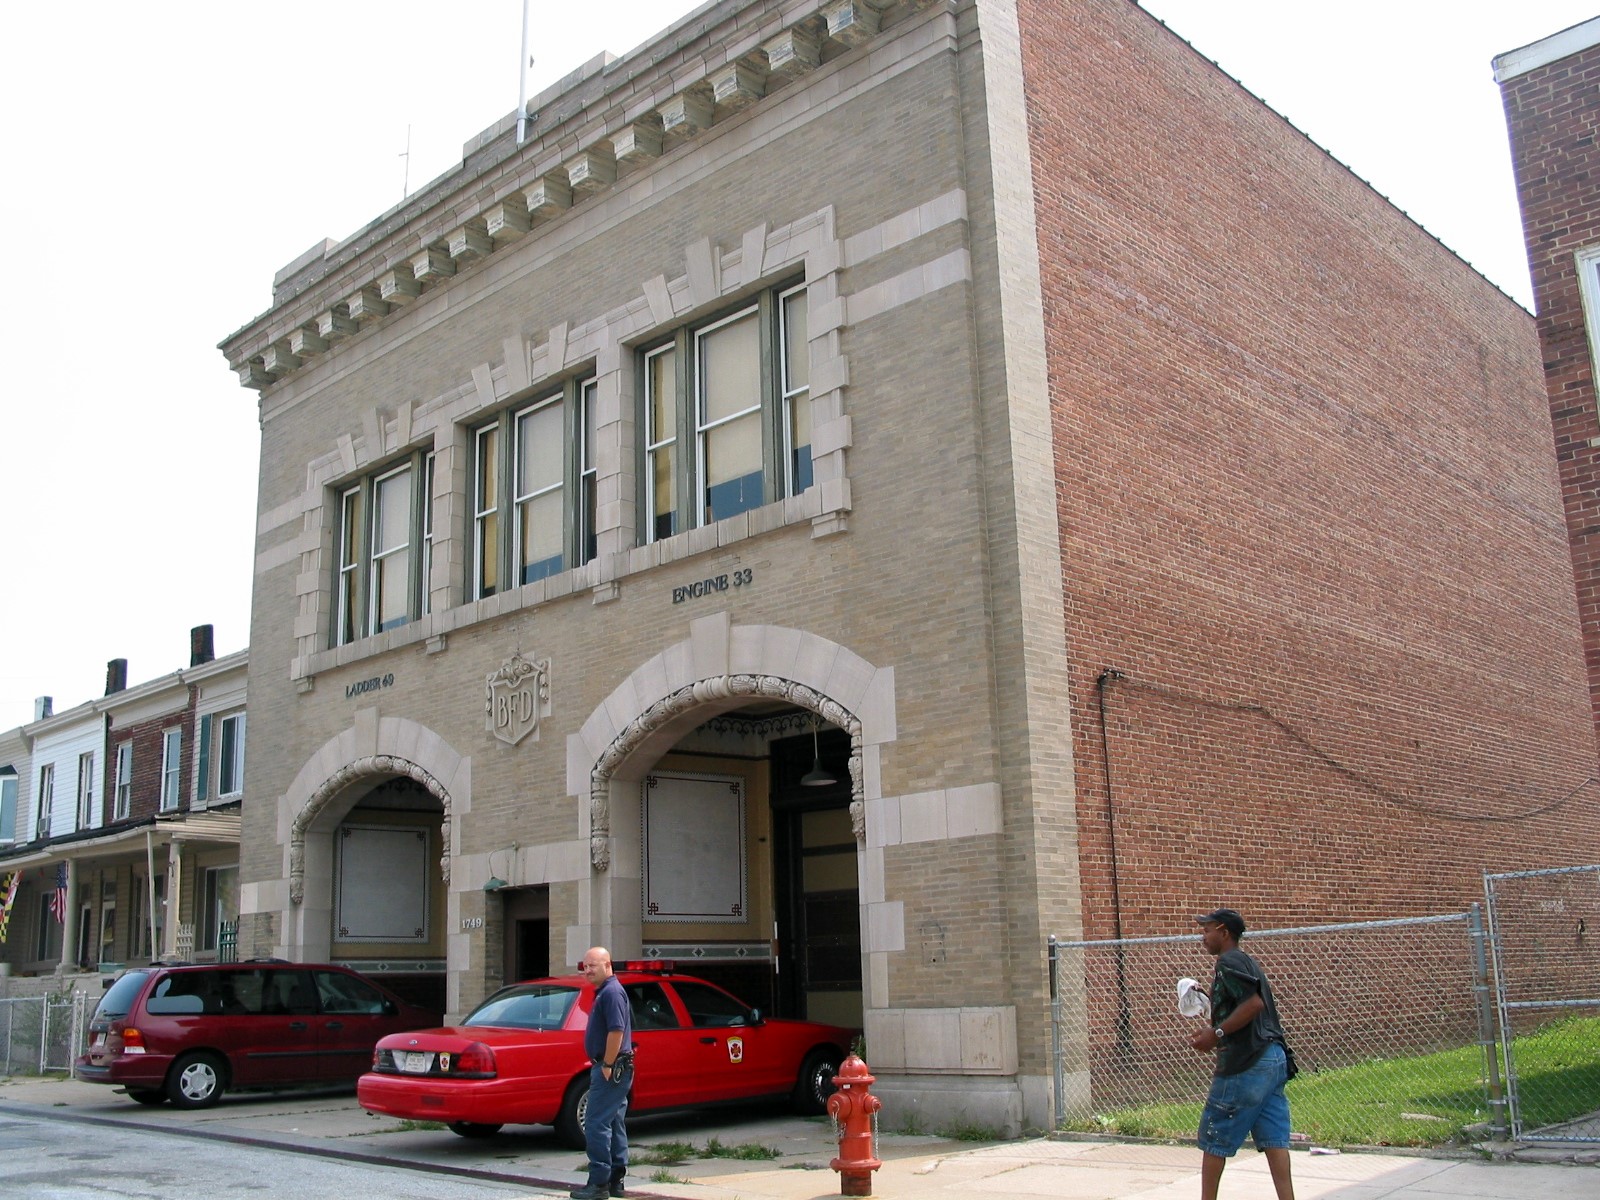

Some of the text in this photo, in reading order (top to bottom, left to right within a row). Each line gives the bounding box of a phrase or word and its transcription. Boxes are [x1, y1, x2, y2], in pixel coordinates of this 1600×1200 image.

[672, 568, 753, 604] ENGINE 33
[345, 676, 381, 698] LADDER
[498, 690, 534, 734] BFD
[462, 917, 482, 929] 1749
